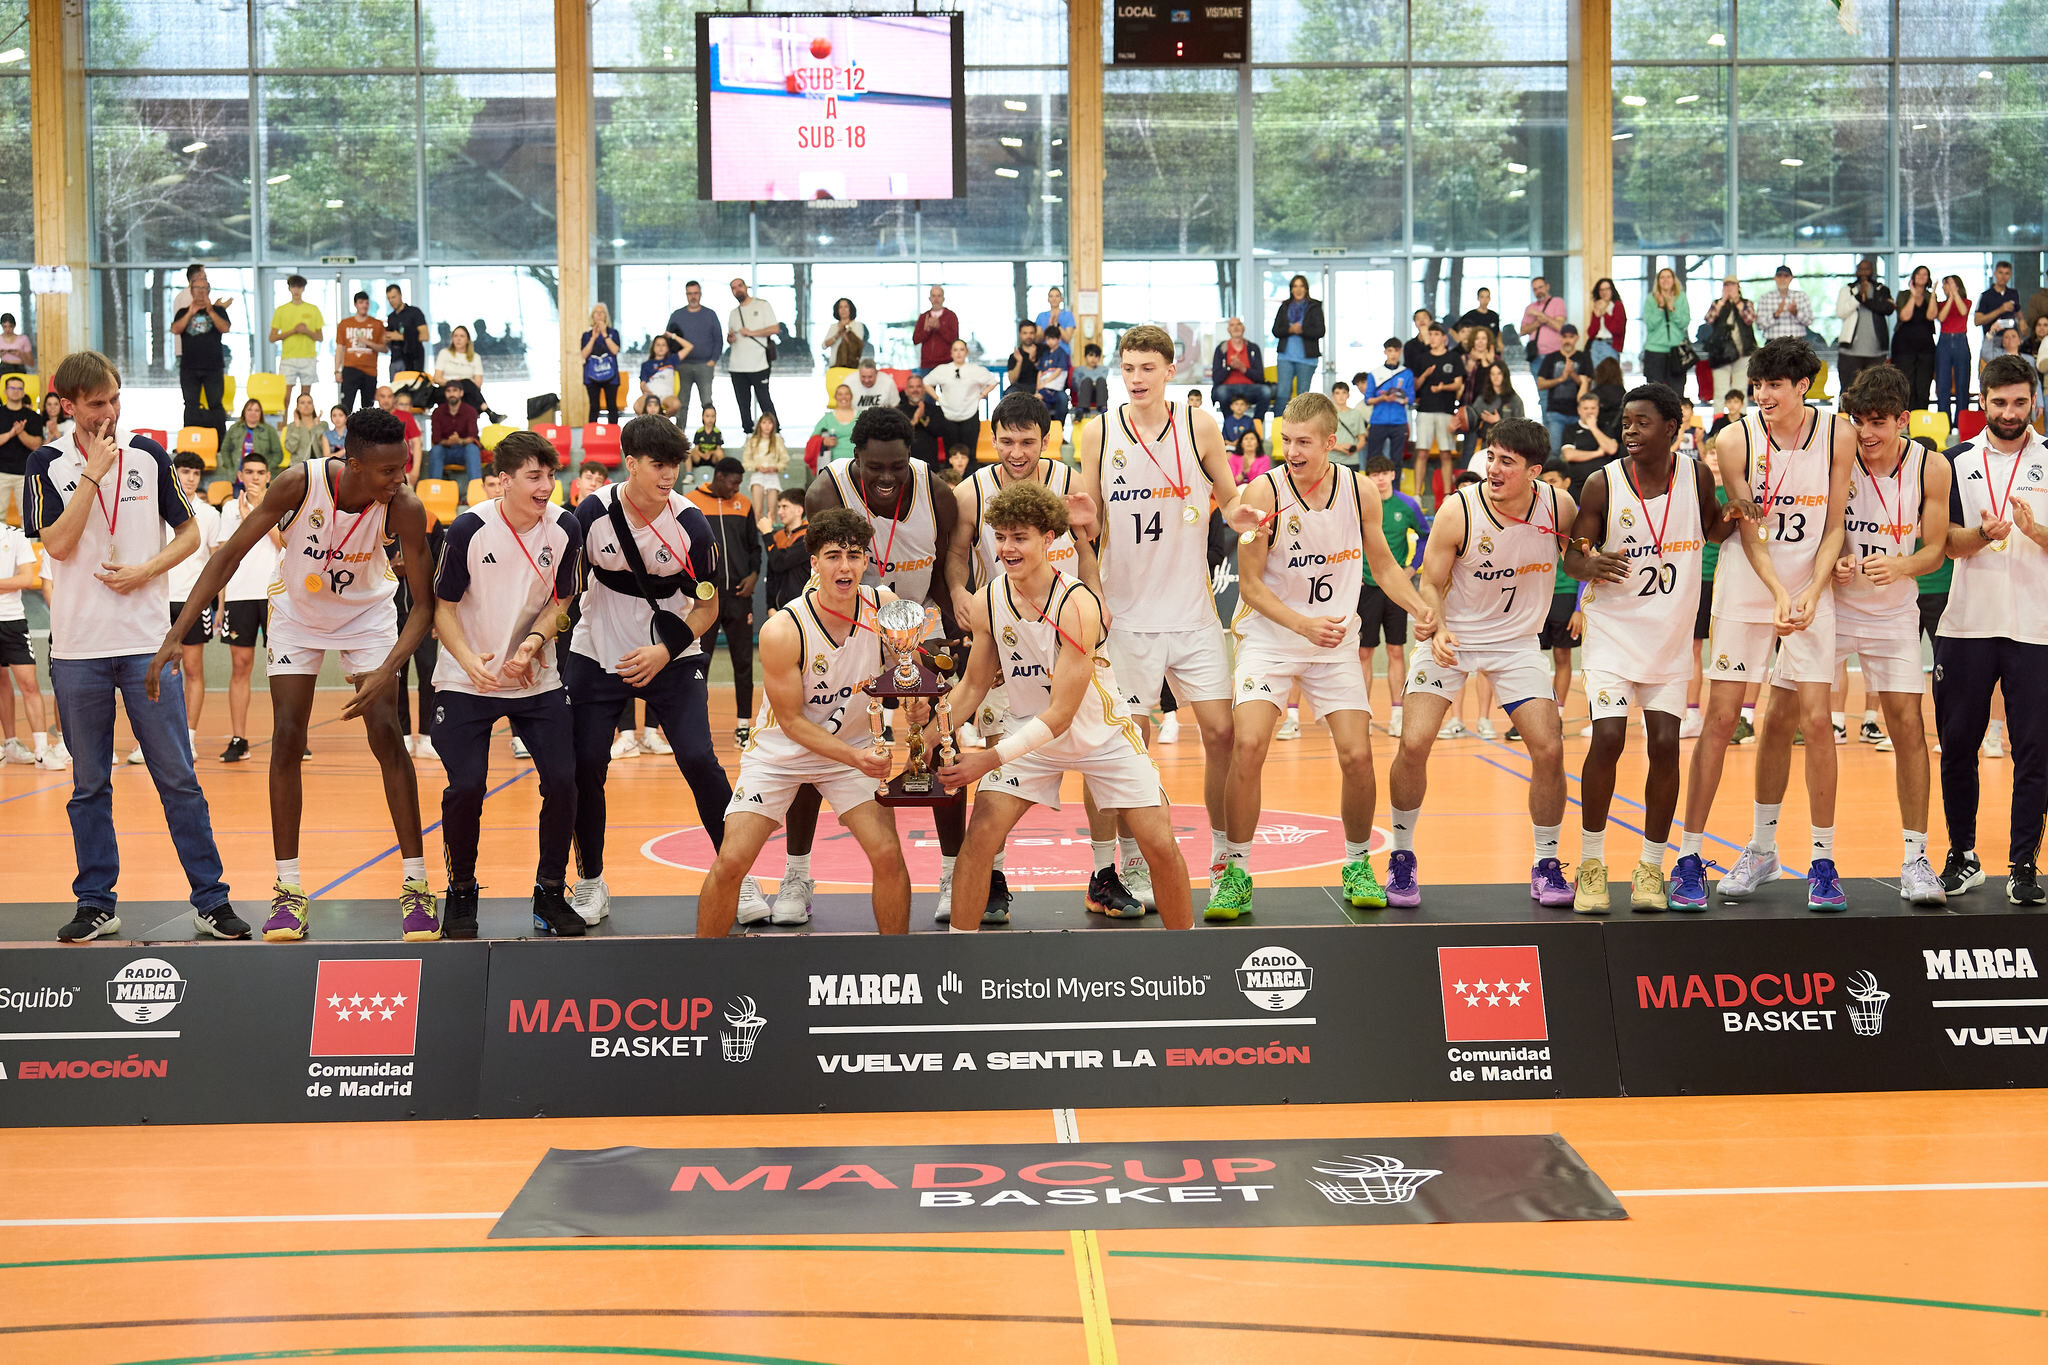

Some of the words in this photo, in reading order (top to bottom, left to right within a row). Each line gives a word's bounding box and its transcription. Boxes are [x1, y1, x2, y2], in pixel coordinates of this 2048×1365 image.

[1118, 6, 1156, 18] LOCAL
[1205, 6, 1243, 18] VISITANTE
[795, 67, 865, 91] SUB-12
[826, 97, 837, 119] A
[798, 125, 866, 149] SUB-18
[857, 394, 882, 407] NIKE
[1131, 511, 1163, 545] 14
[1775, 512, 1806, 542] 13
[303, 546, 374, 563] AUTOHER
[1288, 548, 1361, 569] AUTOHERO
[327, 568, 355, 595] 19
[1473, 562, 1552, 581] AUTOHERO
[1637, 562, 1677, 596] 20
[1307, 573, 1333, 605] 16
[1501, 586, 1517, 613] 7
[827, 706, 845, 736] 5
[125, 968, 172, 979] RADIO
[1251, 956, 1297, 967] RADIO
[1922, 948, 2039, 980] MARCA
[808, 973, 923, 1006] MARCA
[981, 978, 1051, 1000] Bristol
[1057, 976, 1126, 1002] Myers
[1246, 971, 1305, 988] MARCA
[1636, 972, 1836, 1009] MADCUP
[116, 983, 176, 1001] MARCA
[508, 998, 713, 1033] MADCUP
[1723, 1010, 1837, 1032] BASKET
[590, 1036, 708, 1058] BASKET
[816, 1053, 943, 1073] VUELVE
[952, 1053, 977, 1071] A
[986, 1050, 1103, 1070] SENTIR
[1112, 1048, 1157, 1068] LA
[1166, 1040, 1311, 1067] EMOCIÓN
[1447, 1046, 1551, 1062] Comunidad
[18, 1053, 168, 1080] EMOCIÓN
[308, 1062, 414, 1077] Comunidad
[1449, 1066, 1475, 1082] de
[1481, 1065, 1553, 1081] Madrid
[306, 1081, 332, 1097] de
[339, 1081, 413, 1097] Madrid
[670, 1157, 1277, 1192] MADCUP
[919, 1184, 1274, 1208] BASKET
